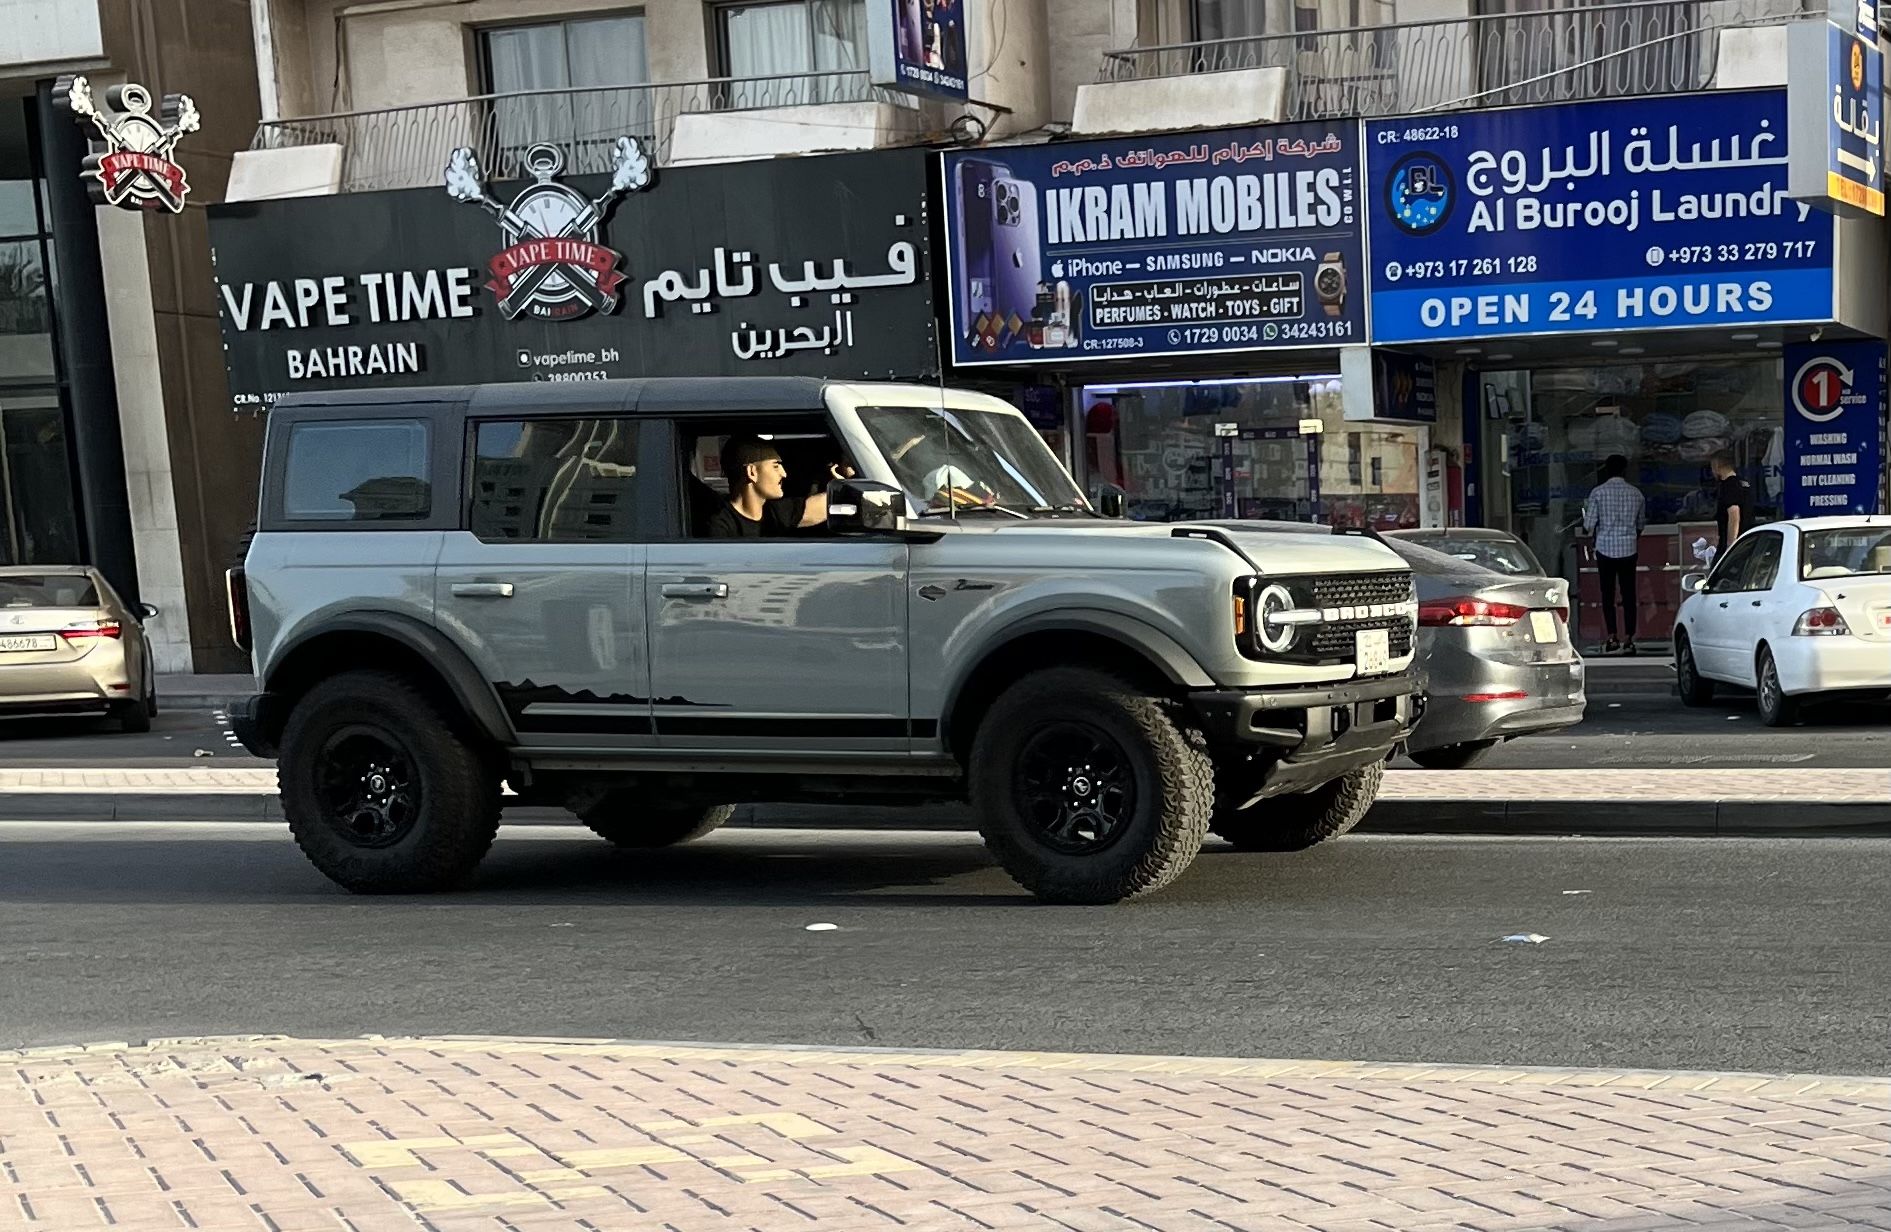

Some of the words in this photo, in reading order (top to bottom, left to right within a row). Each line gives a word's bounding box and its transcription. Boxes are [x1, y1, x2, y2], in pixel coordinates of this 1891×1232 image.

[1275, 133, 1342, 159] شركة
[1377, 130, 1400, 144] CR:
[1403, 126, 1459, 142] 48622-18
[1623, 119, 1789, 173] غسلة
[111, 155, 141, 169] VAPE
[1115, 145, 1209, 169] للهواتف
[1212, 139, 1273, 165] إكرام
[1466, 130, 1611, 196] البروج
[1045, 181, 1168, 244] IKRAM
[1175, 167, 1342, 236] MOBILES
[1467, 198, 1505, 233] Al
[1516, 189, 1639, 232] Burooj
[505, 241, 551, 268] VAPE
[555, 241, 596, 265] TIME
[768, 214, 916, 307] فيب
[1068, 258, 1123, 277] iPhone
[1146, 251, 1224, 271] SAMSUNG
[1251, 246, 1316, 264] NOKIA
[1668, 246, 1712, 264] +973
[1717, 244, 1739, 262] 33
[1744, 242, 1777, 261] 279
[1783, 240, 1815, 258] 717
[1405, 261, 1444, 279] +973
[1449, 260, 1468, 276] 17
[1472, 258, 1501, 275] 261
[1507, 256, 1537, 273] 128
[643, 247, 754, 318] تايم
[1251, 276, 1300, 293] ساعات
[221, 275, 349, 331] VAPE
[360, 267, 474, 322] TIME
[1093, 287, 1133, 305] هدايا
[1420, 293, 1530, 327] OPEN
[1548, 290, 1598, 321] 24
[1617, 281, 1773, 318] HOURS
[1095, 304, 1161, 323] PERFUMES
[1170, 301, 1216, 319] WATCH
[1226, 298, 1260, 316] TOYS
[1270, 297, 1300, 314] GIFT
[731, 310, 853, 359] البحرين
[1184, 328, 1219, 344] 1729
[1222, 325, 1258, 342] 0034
[1281, 321, 1352, 339] 34243161
[287, 342, 419, 379] BAHRAIN
[533, 348, 619, 368] vapetime_bh
[1812, 371, 1828, 406] 1
[1810, 432, 1847, 445] WASHING
[1800, 453, 1832, 466] NORMAL
[1833, 453, 1857, 465] WASH
[1801, 475, 1818, 487] DRY
[1819, 473, 1856, 486] CLEANING
[1810, 494, 1848, 507] PRESSING
